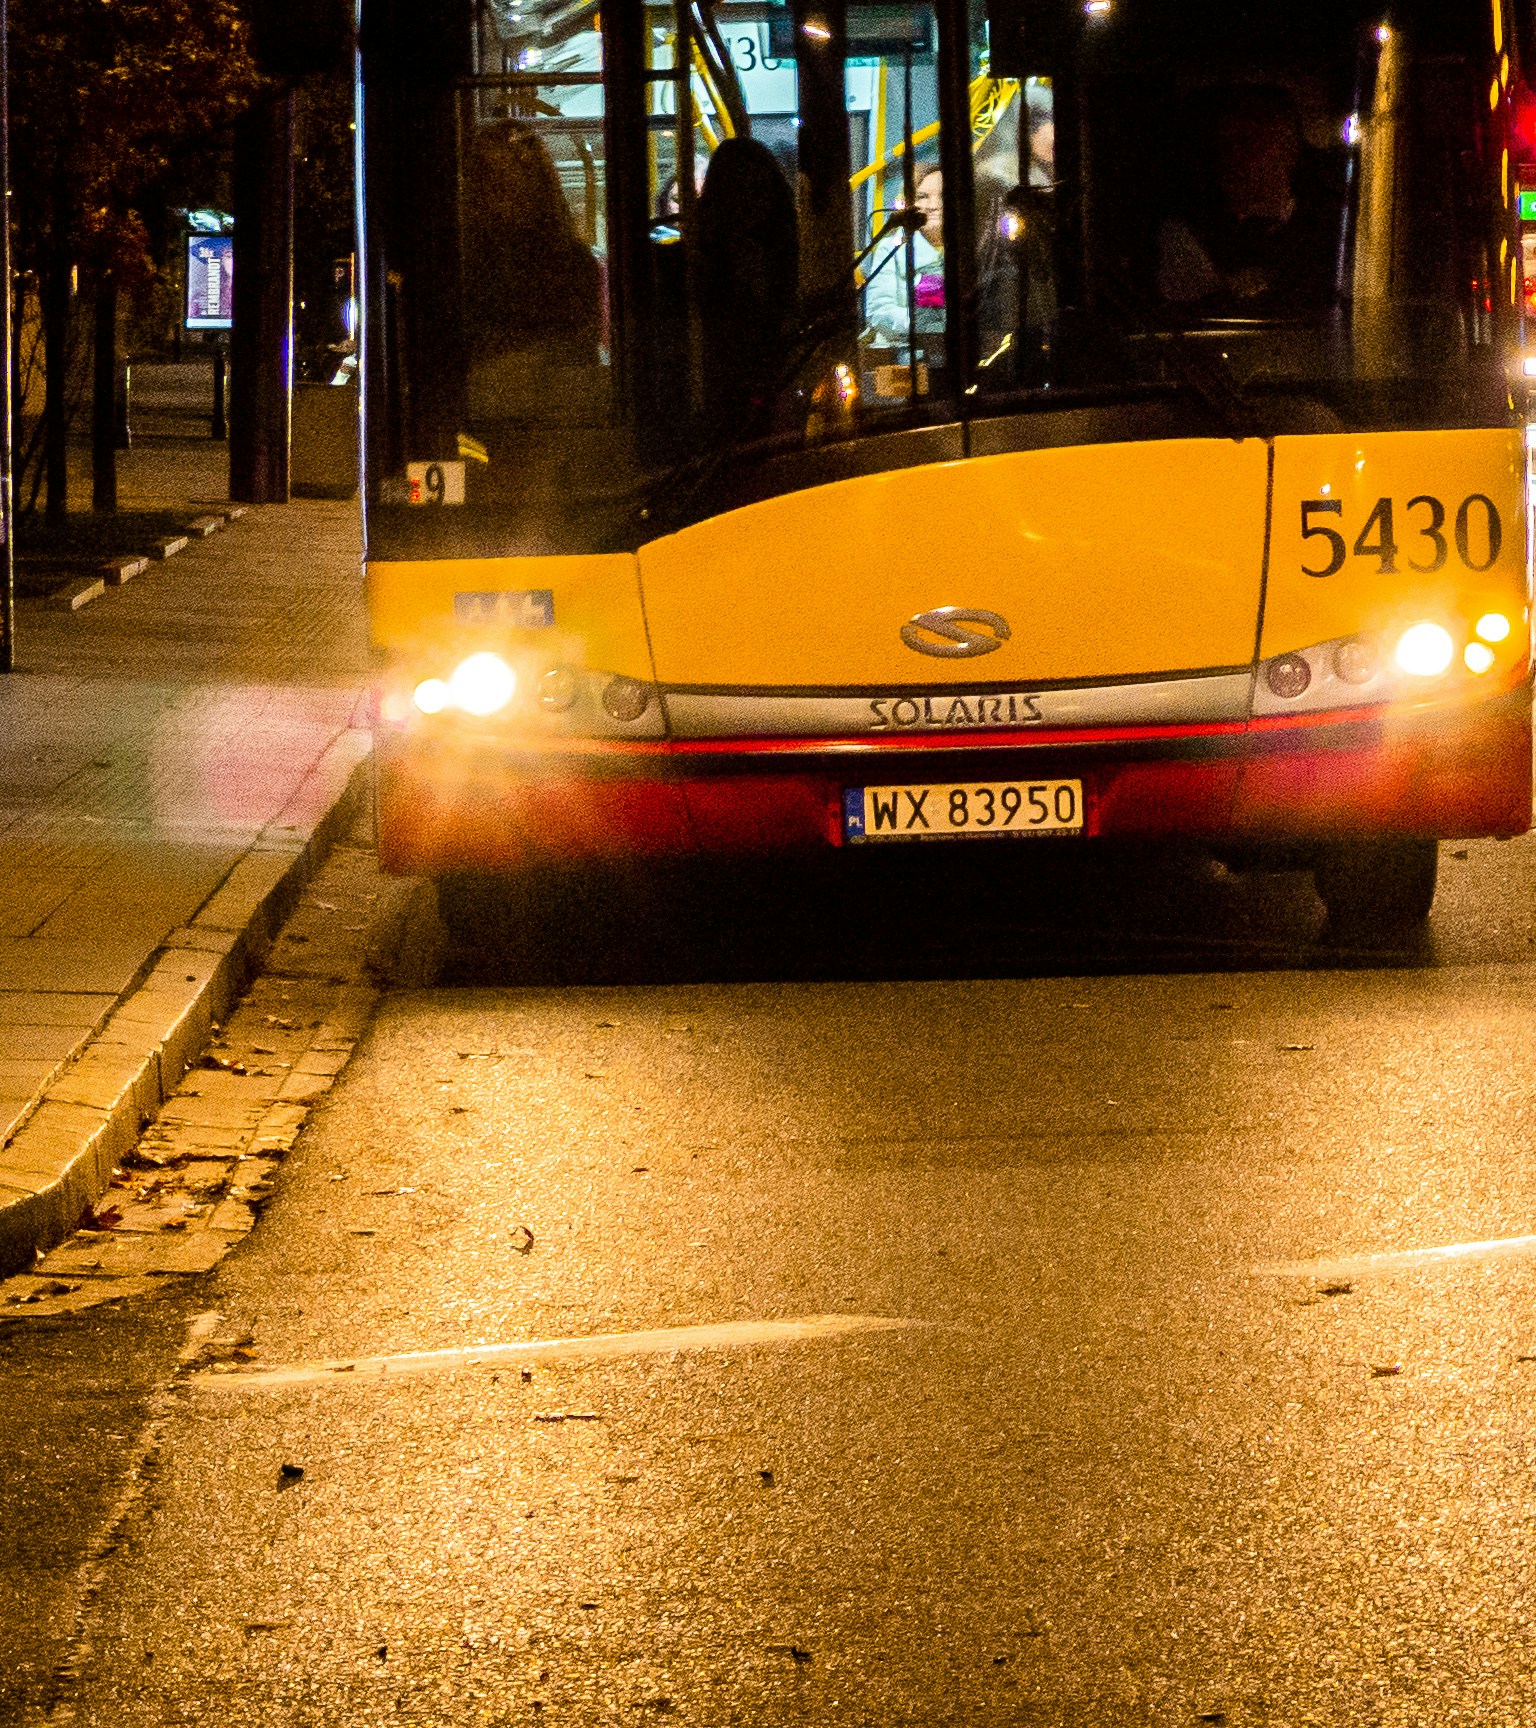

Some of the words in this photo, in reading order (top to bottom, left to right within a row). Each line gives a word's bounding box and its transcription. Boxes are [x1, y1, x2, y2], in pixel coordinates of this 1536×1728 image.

[207, 257, 221, 316] REMBRANDT
[425, 462, 446, 506] 9
[1301, 493, 1502, 578] 5430
[869, 695, 1042, 726] SOLARIS
[848, 816, 863, 827] PL
[872, 789, 930, 830] WX
[948, 785, 1076, 827] 83950
